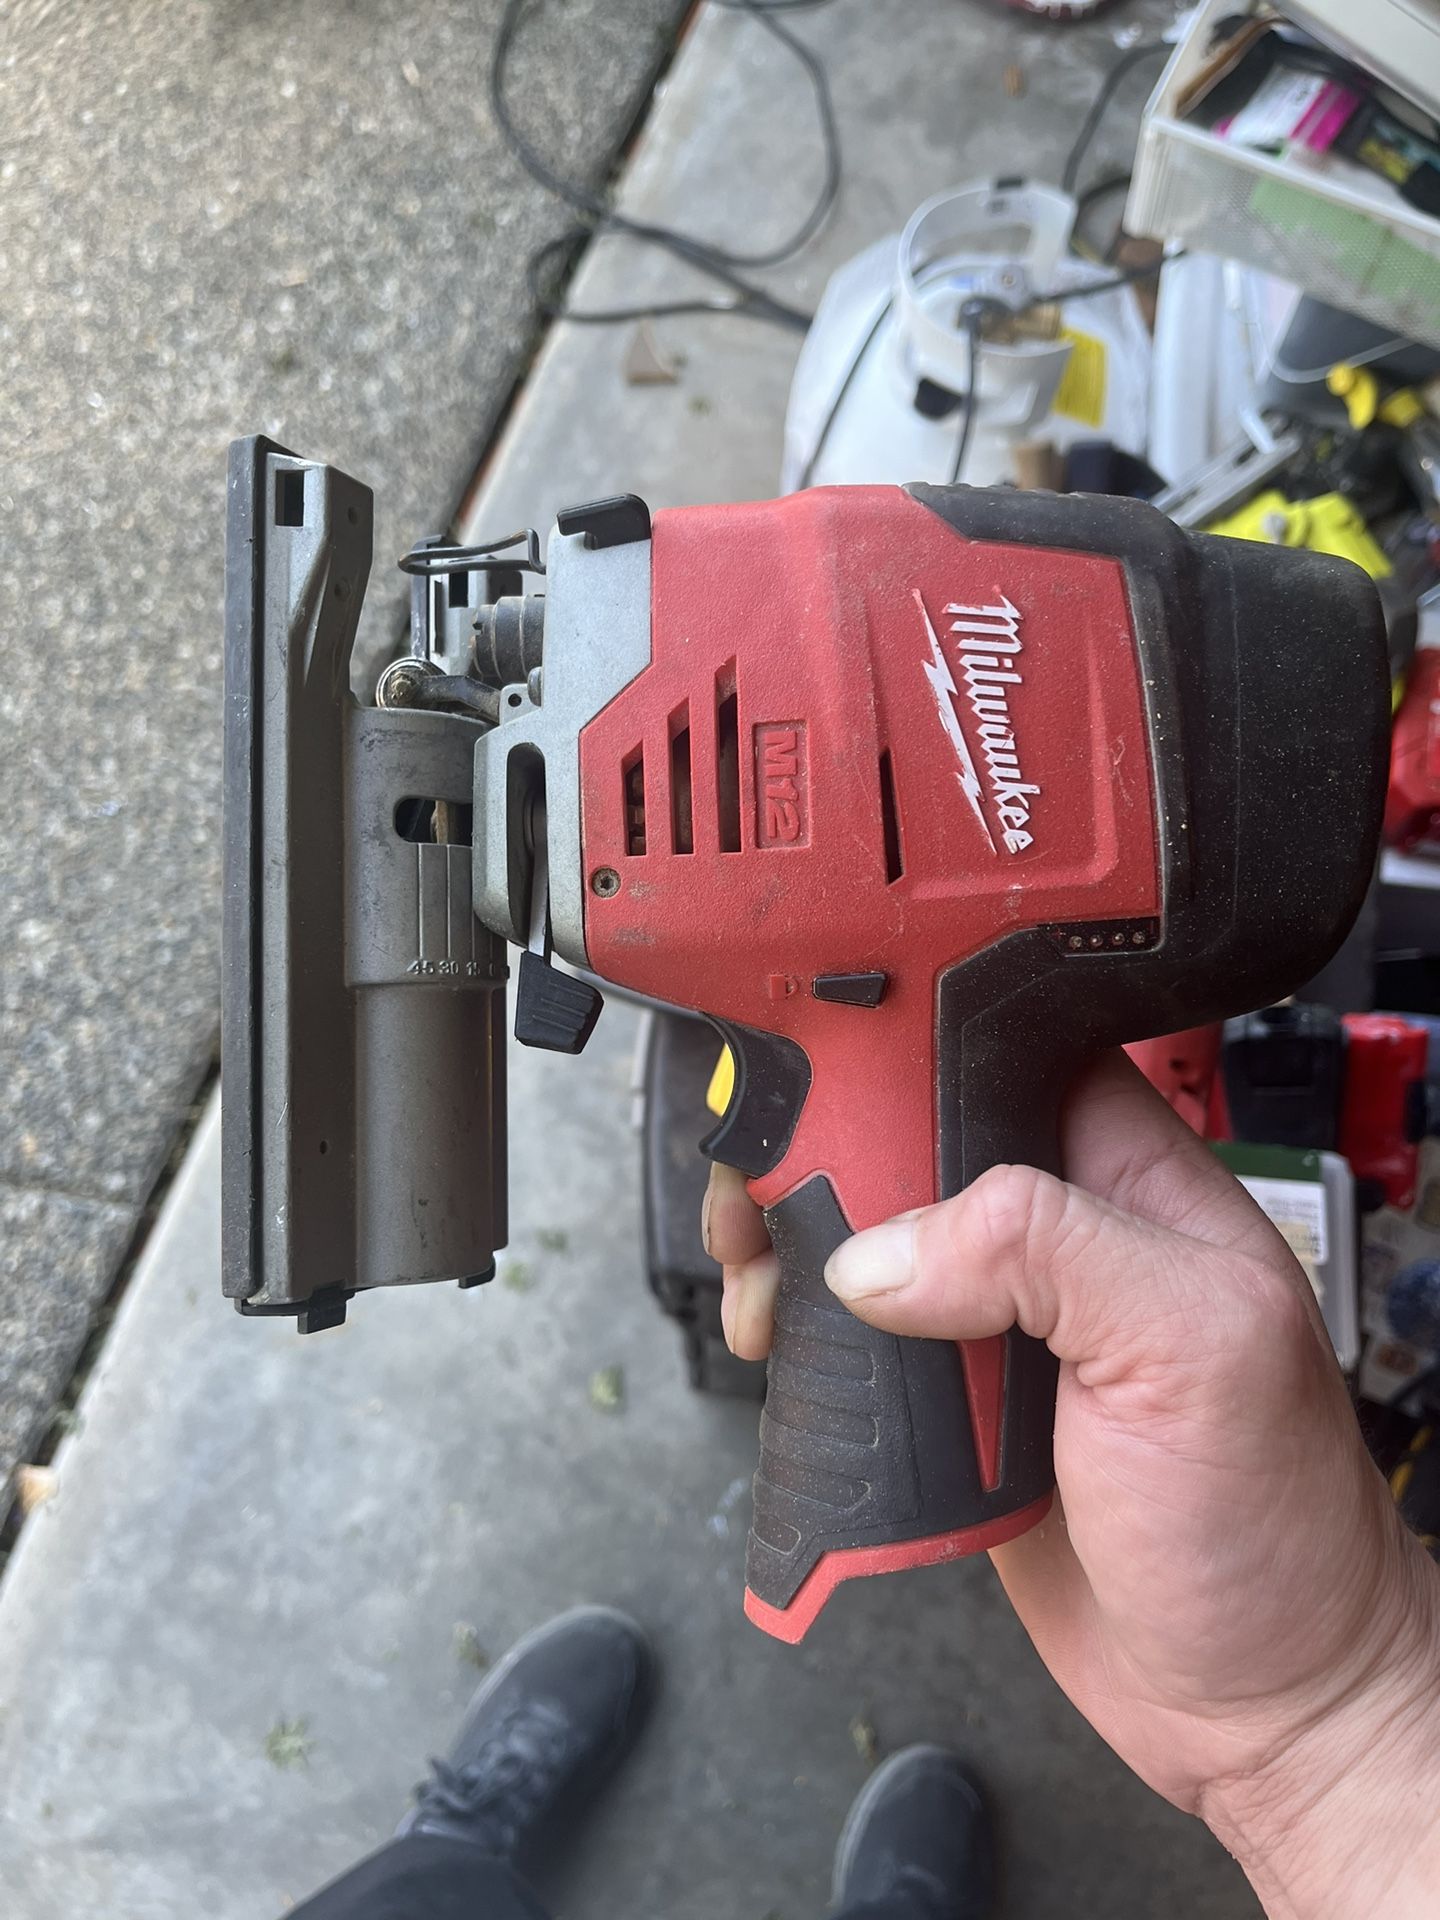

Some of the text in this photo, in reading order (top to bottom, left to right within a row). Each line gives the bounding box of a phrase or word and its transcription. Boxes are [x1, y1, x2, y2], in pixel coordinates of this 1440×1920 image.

[942, 586, 1041, 854] Milwaukee
[764, 729, 800, 842] M12
[406, 960, 435, 975] 45
[438, 960, 459, 975] 30
